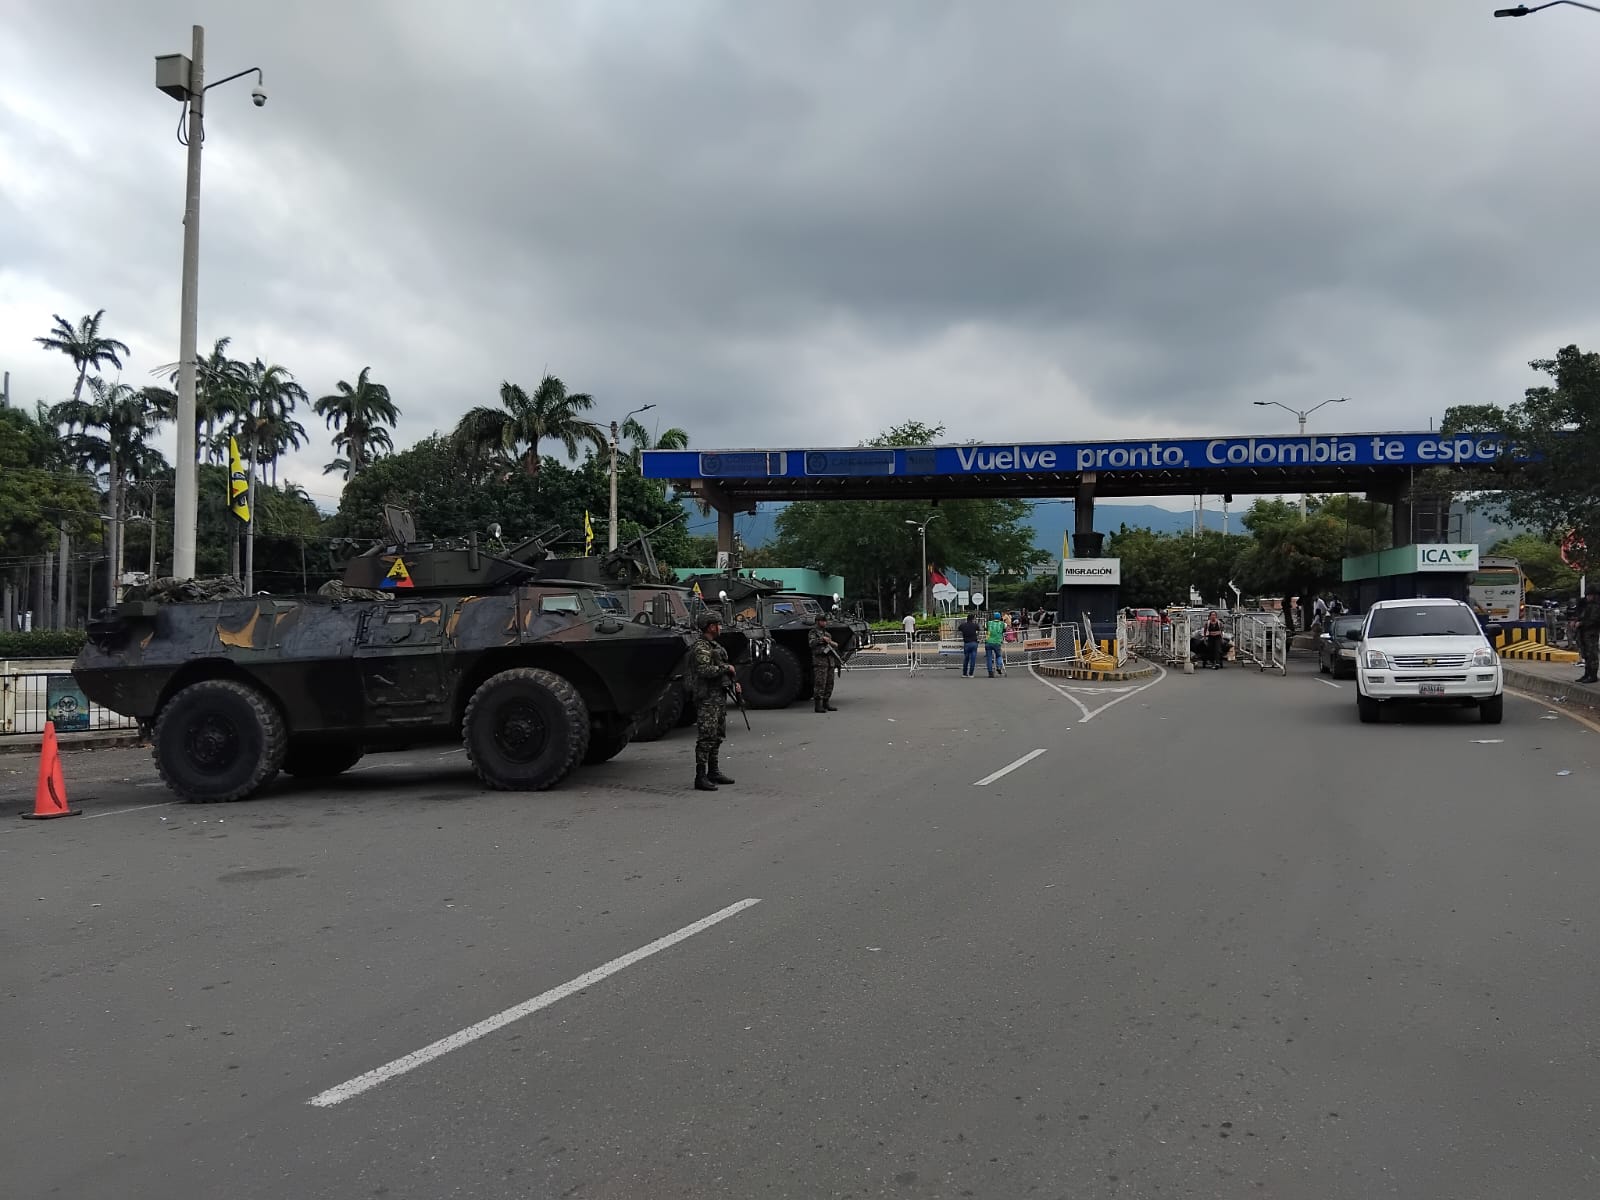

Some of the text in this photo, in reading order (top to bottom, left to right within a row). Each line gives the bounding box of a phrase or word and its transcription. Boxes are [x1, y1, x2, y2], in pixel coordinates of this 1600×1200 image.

[956, 446, 1056, 470] Vuelve
[1076, 443, 1190, 471] pronto.
[1205, 436, 1356, 464] Colombia
[1370, 436, 1405, 461] te
[1421, 549, 1452, 563] ICA
[1065, 567, 1112, 575] MIGRACIÓN
